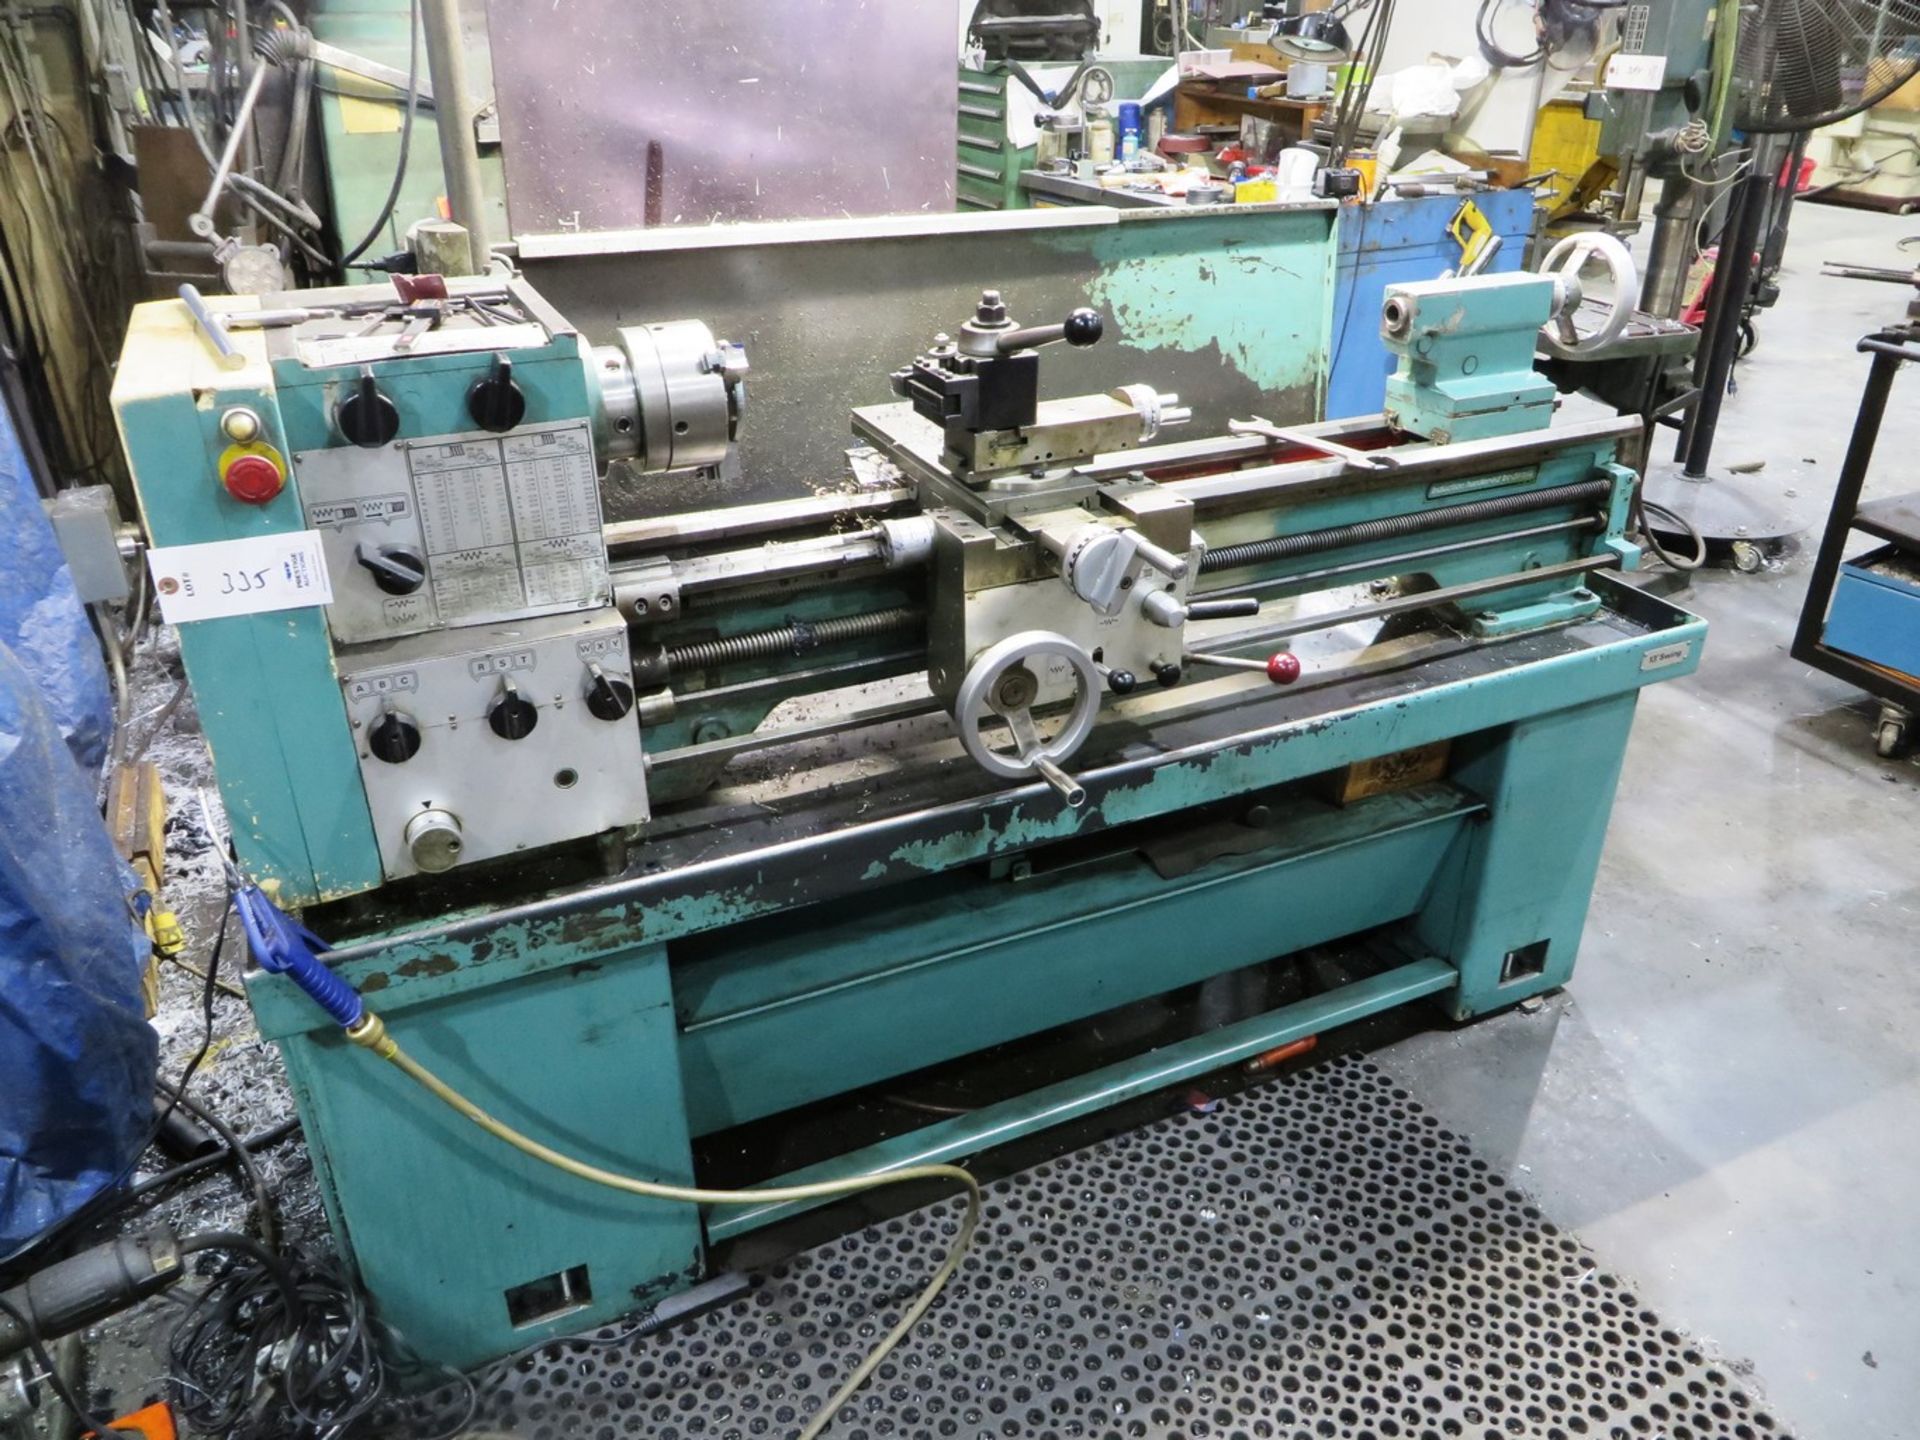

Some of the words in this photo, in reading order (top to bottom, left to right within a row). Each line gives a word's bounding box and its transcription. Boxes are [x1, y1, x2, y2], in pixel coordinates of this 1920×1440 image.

[291, 553, 303, 588] PRESTIGE
[299, 552, 310, 586] AUCTIONS
[221, 568, 271, 594] 335
[580, 645, 590, 653] W
[477, 663, 485, 671] R
[499, 659, 506, 668] S
[379, 680, 386, 688] B
[400, 676, 408, 685] C
